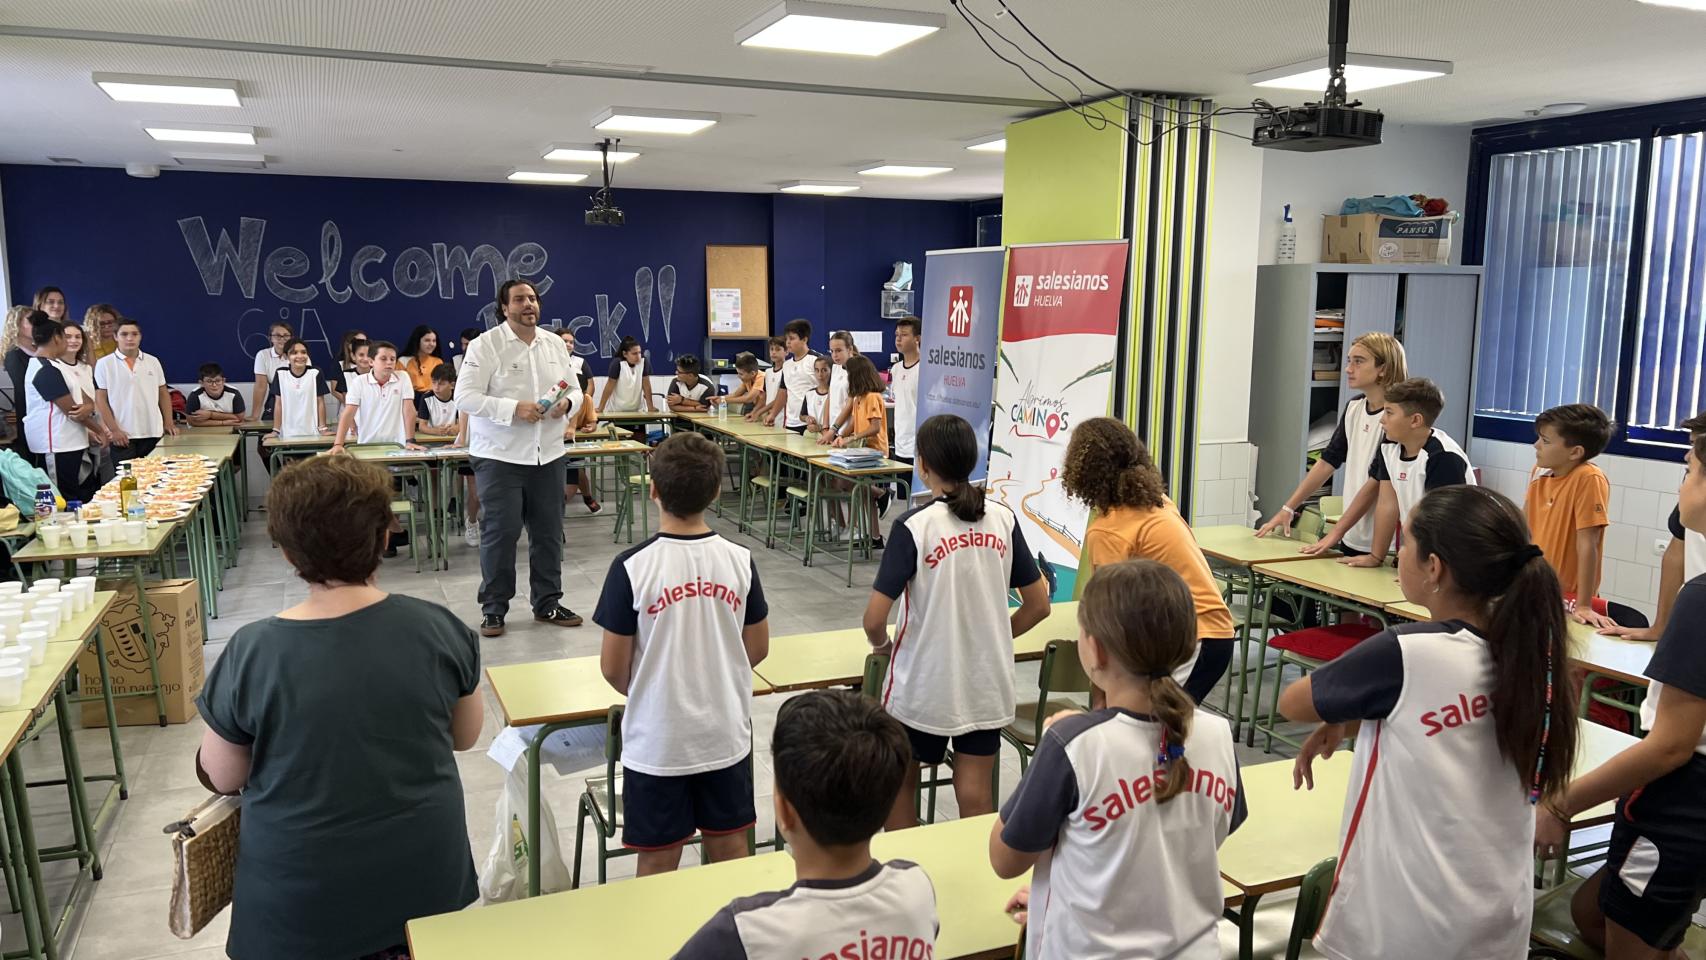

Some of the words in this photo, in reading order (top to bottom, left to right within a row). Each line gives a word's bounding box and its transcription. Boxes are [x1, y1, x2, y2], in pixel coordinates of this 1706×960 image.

[1396, 226, 1434, 234] PANSUR
[177, 216, 554, 303] Welcome
[1036, 270, 1109, 291] salesianos
[1033, 295, 1063, 307] HUELVA
[928, 345, 986, 370] salesianos
[943, 375, 966, 388] HUELVA
[1011, 404, 1069, 438] CAMINOS
[925, 528, 1007, 569] salesianos
[1083, 768, 1235, 832] salesanos
